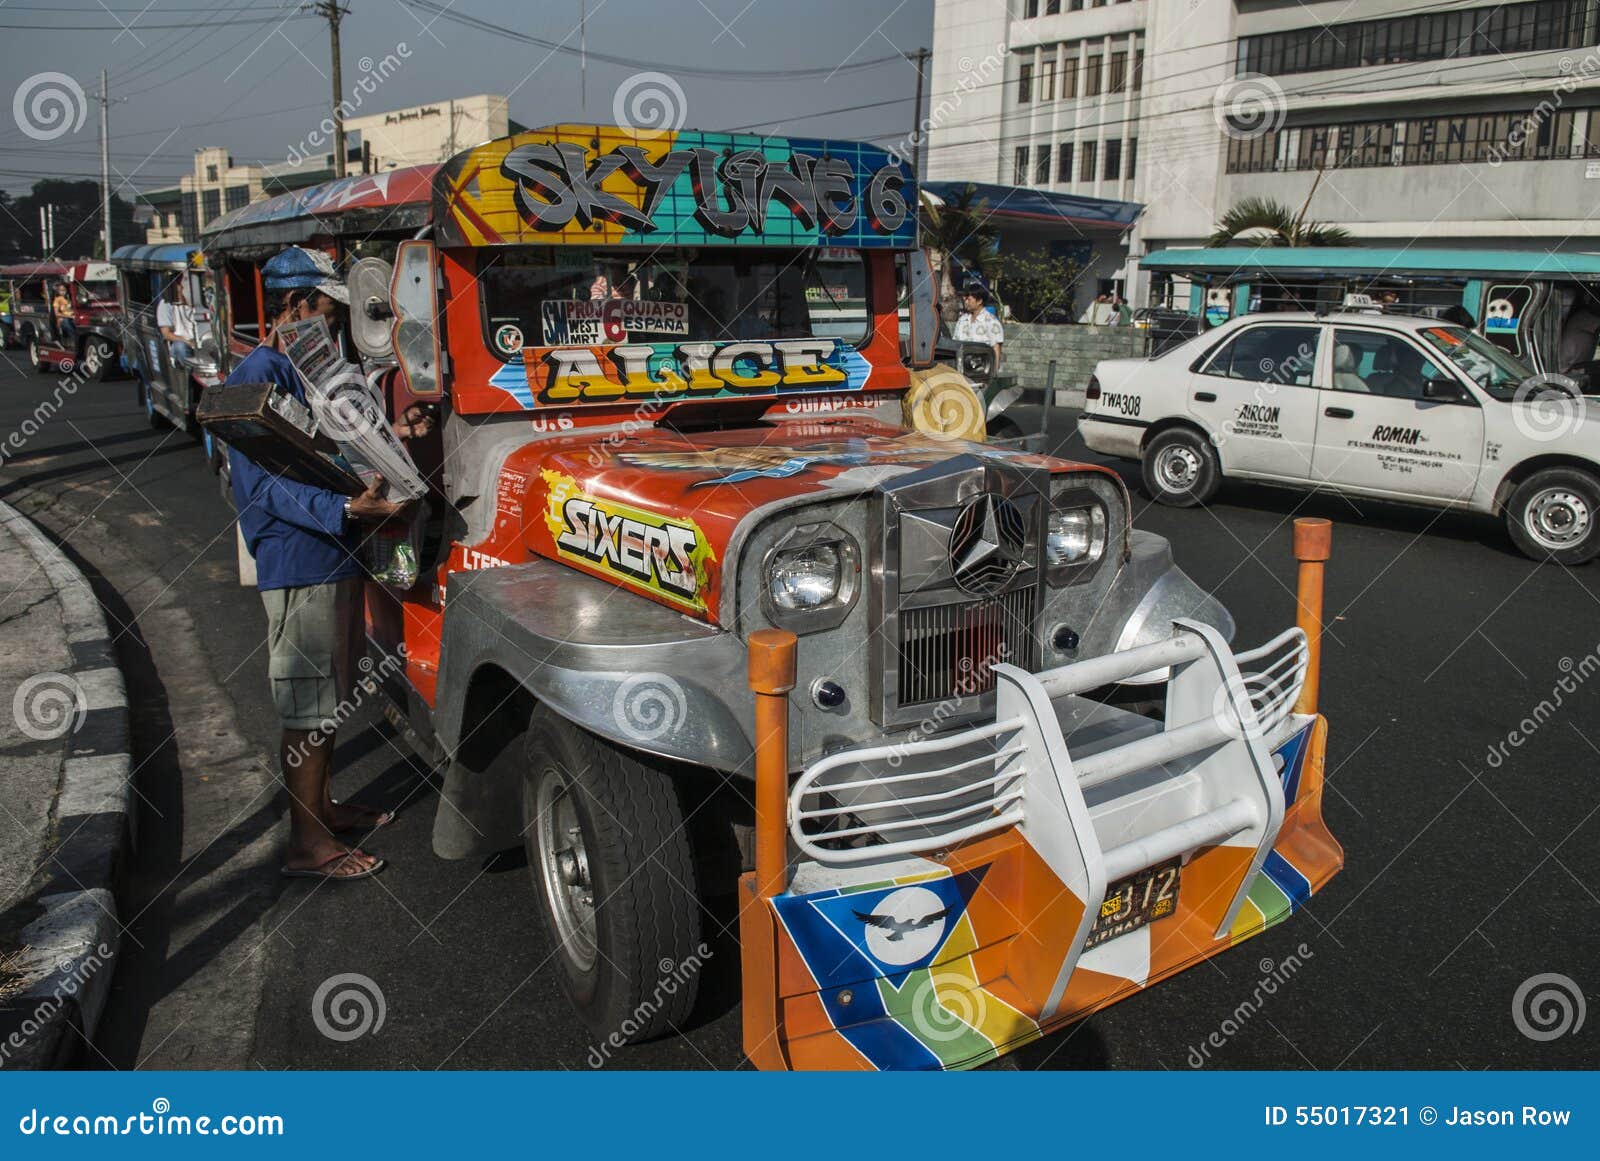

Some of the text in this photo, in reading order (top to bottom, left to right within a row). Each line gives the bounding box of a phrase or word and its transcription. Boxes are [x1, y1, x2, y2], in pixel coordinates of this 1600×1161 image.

[501, 140, 907, 237] SKYLINE 6
[567, 301, 602, 319] PROJ
[603, 301, 626, 342] 6
[623, 303, 685, 317] QUIAPO
[569, 319, 600, 333] WEST
[624, 316, 685, 331] ESPAÑA
[570, 333, 599, 344] MRT
[542, 340, 848, 404] ALICE
[1239, 404, 1281, 423] AIRCON
[1372, 425, 1421, 445] ROMAN
[557, 497, 698, 600] SIXERS
